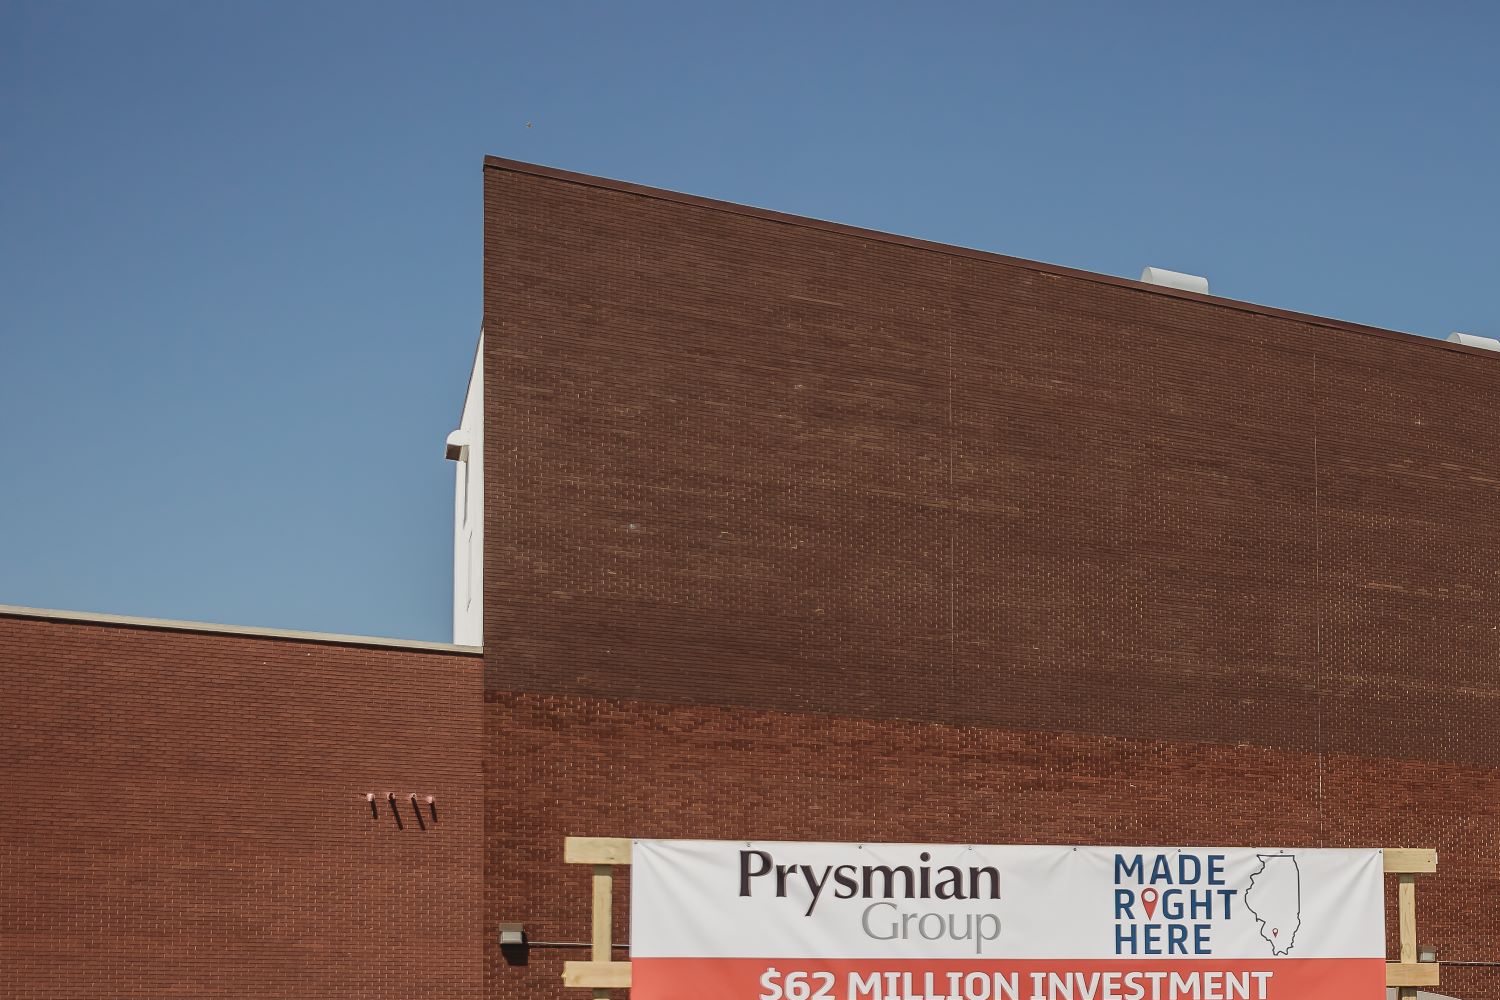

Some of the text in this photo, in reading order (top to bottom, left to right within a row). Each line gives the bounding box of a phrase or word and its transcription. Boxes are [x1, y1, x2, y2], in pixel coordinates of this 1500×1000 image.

[739, 850, 1001, 917] Prysmian
[1114, 854, 1226, 885] MADE
[861, 902, 1001, 954] Group
[1115, 924, 1212, 955] HERE
[1029, 971, 1274, 1000] INVESTMENT
